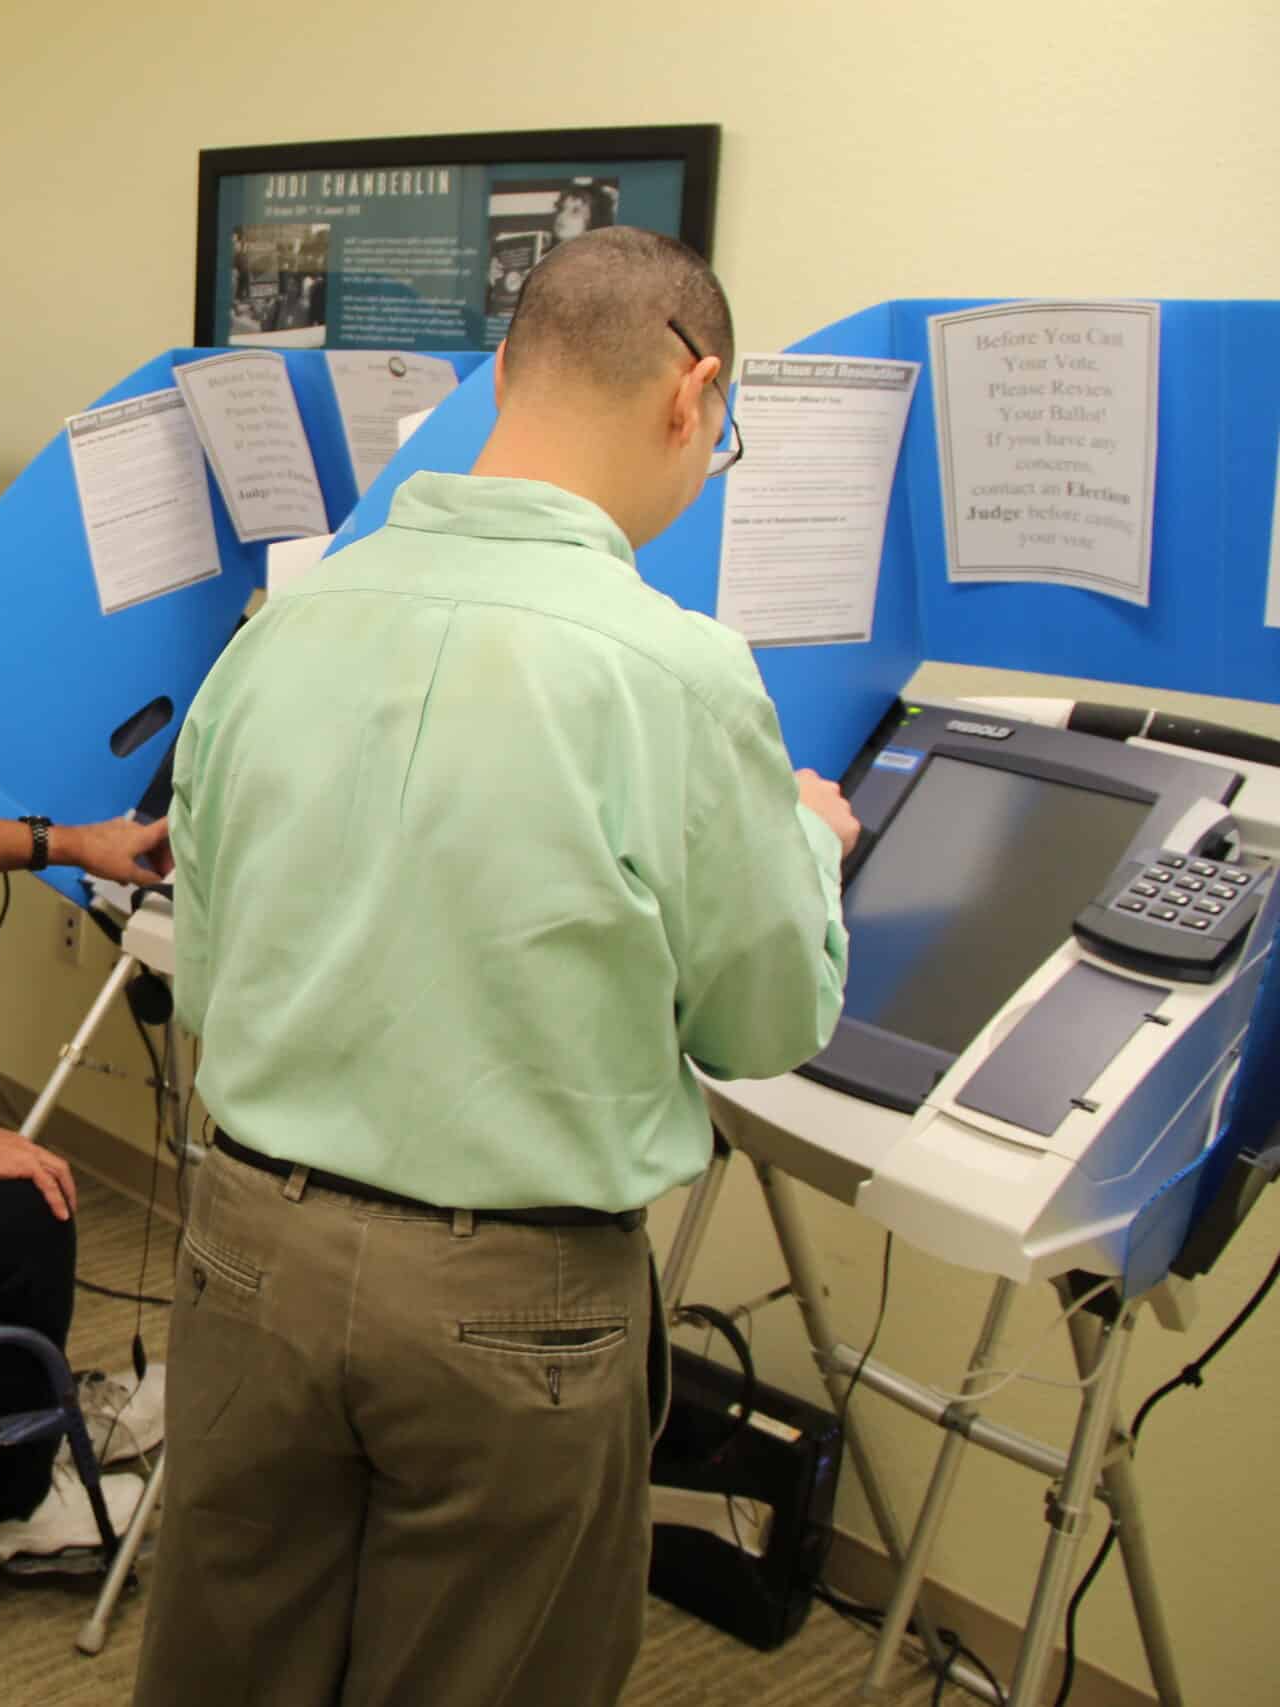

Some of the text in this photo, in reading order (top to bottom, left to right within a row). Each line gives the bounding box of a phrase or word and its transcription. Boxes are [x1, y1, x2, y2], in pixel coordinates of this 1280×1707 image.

[265, 174, 308, 198] JUDI
[975, 329, 1039, 351] Before
[1043, 327, 1081, 345] You
[1000, 353, 1049, 374] Your
[988, 380, 1048, 400] Please
[998, 406, 1045, 424] Your
[1044, 429, 1087, 448] have
[1065, 479, 1132, 505] Election
[964, 504, 1024, 524] Judge
